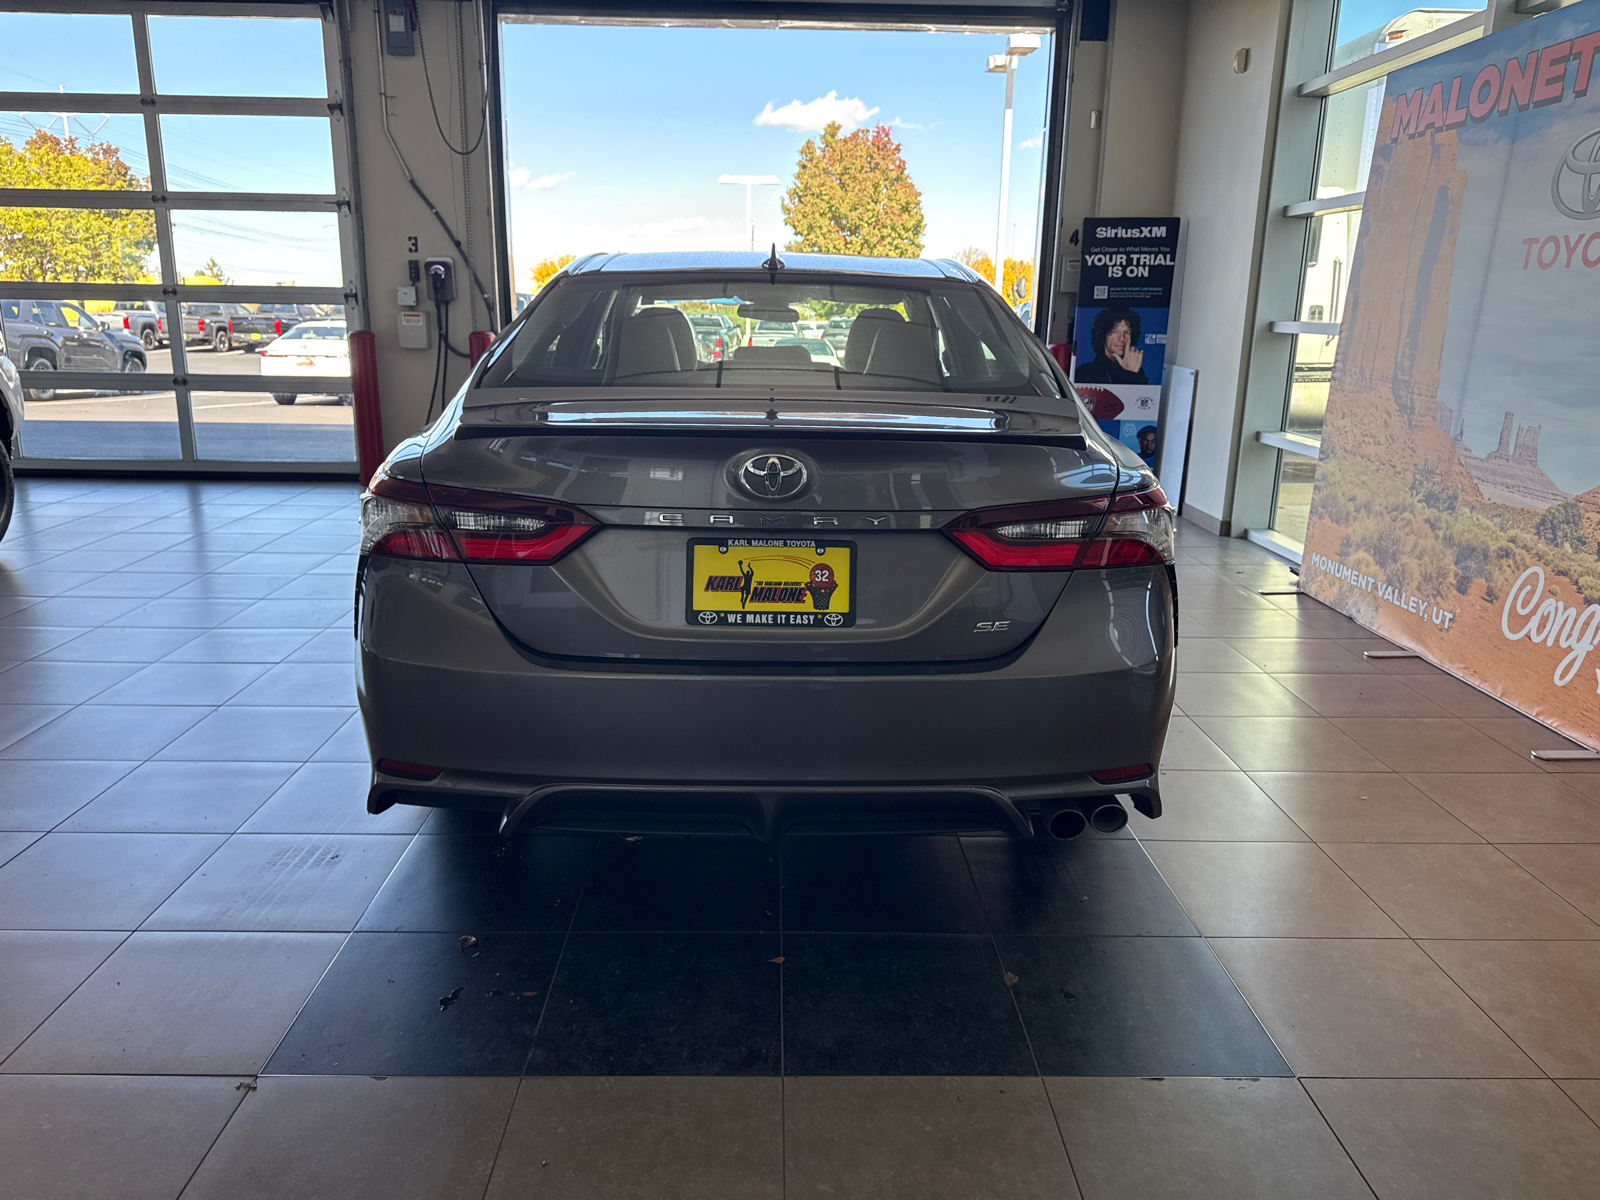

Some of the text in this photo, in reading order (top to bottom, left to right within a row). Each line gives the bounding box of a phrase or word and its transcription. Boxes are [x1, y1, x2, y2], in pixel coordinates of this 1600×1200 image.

[1069, 229, 1079, 247] 4
[1095, 226, 1167, 238] SiriusXM
[407, 236, 418, 253] 3
[1085, 254, 1127, 266] YOUR
[1130, 254, 1175, 265] TRIAL
[1108, 266, 1149, 277] IS ON
[658, 513, 890, 525] CAMRY
[727, 539, 750, 547] KARL
[751, 539, 784, 547] MALONE
[814, 570, 829, 582] 32
[704, 575, 744, 592] KARL
[749, 587, 808, 603] MALONE
[1311, 552, 1454, 628] MONUMENT VALLEY, UT
[727, 614, 815, 624] WE MAKE IT EASY
[973, 620, 1011, 633] SE
[1501, 566, 1600, 686] Cong
